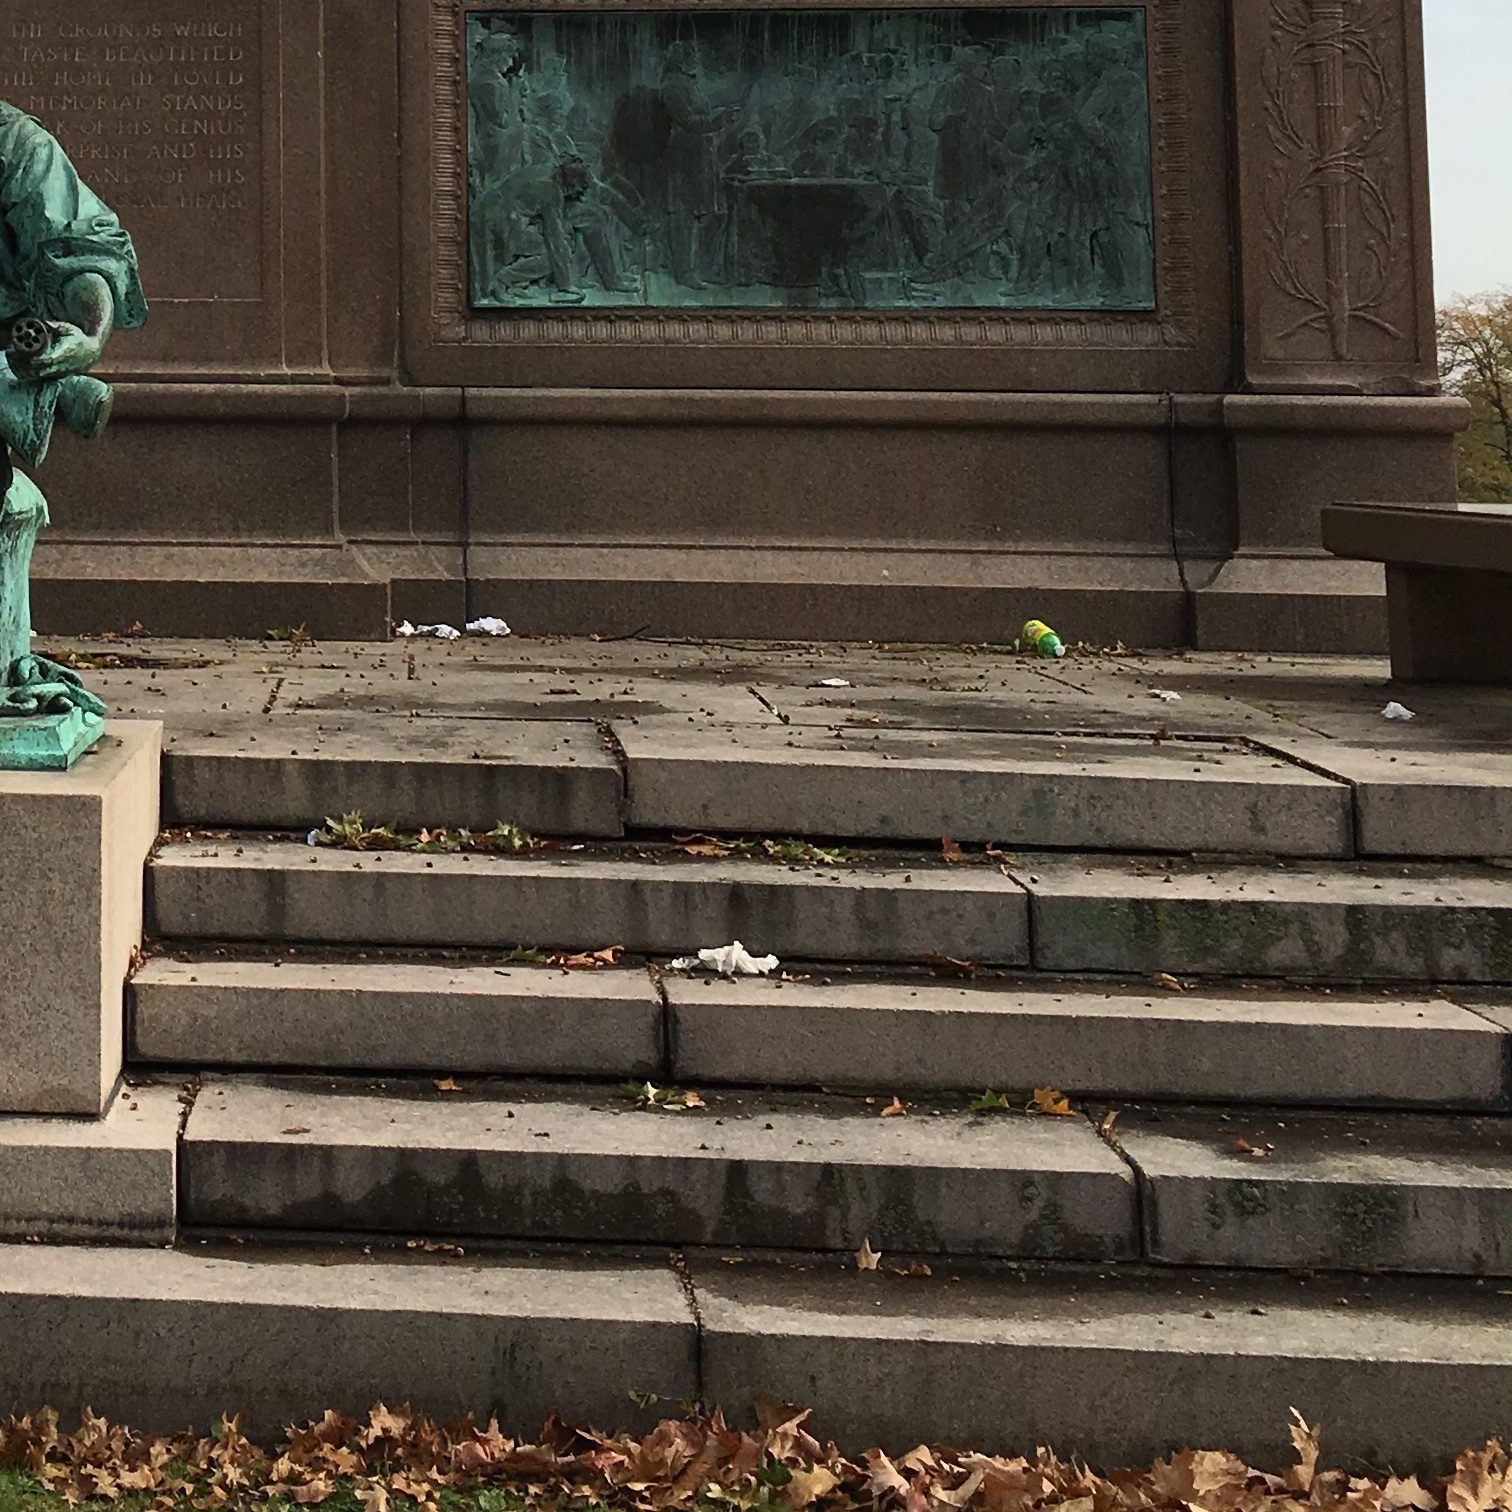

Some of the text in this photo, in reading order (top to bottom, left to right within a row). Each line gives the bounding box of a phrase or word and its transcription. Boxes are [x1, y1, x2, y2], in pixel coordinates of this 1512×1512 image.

[11, 22, 44, 38] THE
[59, 22, 162, 38] GROUNDS
[173, 21, 243, 38] WHICH
[21, 45, 87, 62] TASTE
[104, 45, 244, 62] BEAUTIFIED
[0, 70, 41, 86] THE
[54, 70, 114, 86] HOME
[173, 69, 244, 86] LOVED
[29, 94, 245, 111] MEMORIAL STANDS
[79, 118, 104, 135] OF
[118, 119, 152, 135] HIS
[164, 118, 245, 135] GENIUS
[145, 142, 197, 159] AND
[208, 143, 245, 159] HIS
[159, 167, 187, 183] OF
[208, 167, 245, 184] HIS
